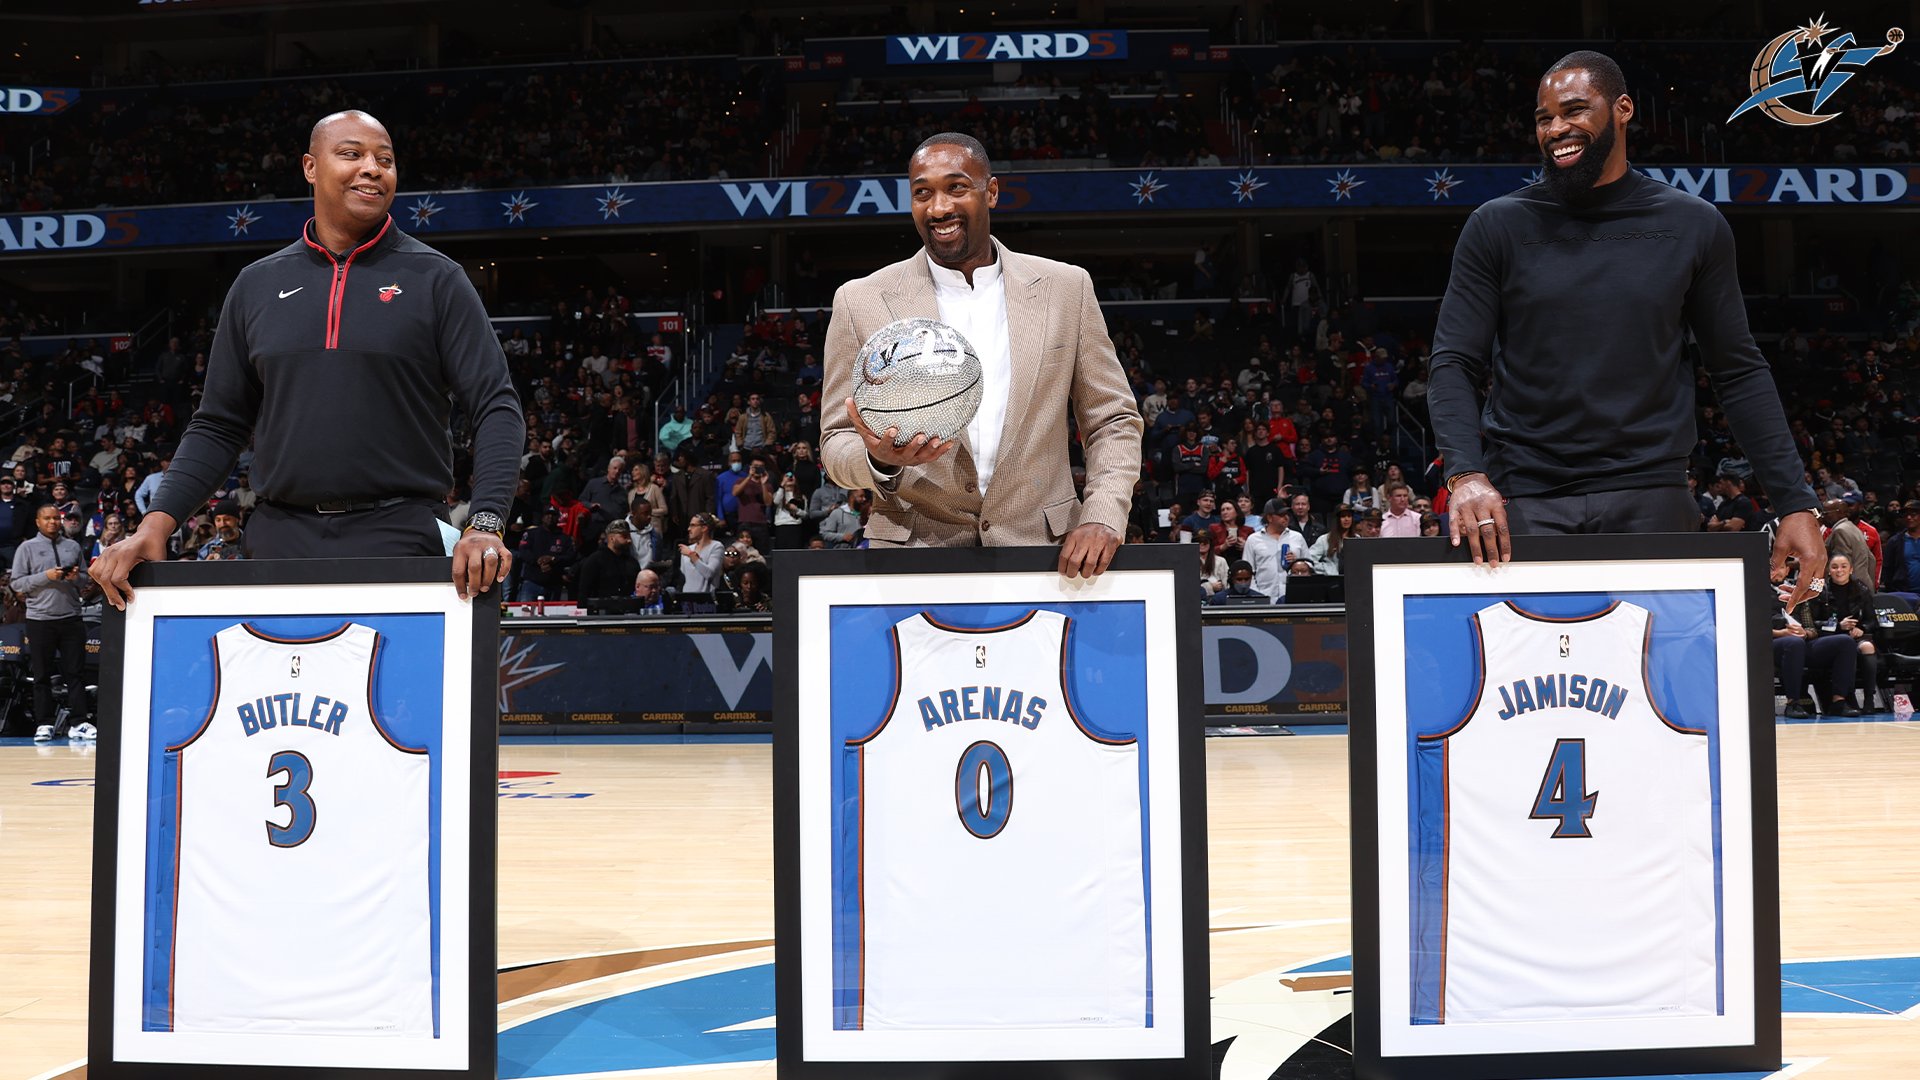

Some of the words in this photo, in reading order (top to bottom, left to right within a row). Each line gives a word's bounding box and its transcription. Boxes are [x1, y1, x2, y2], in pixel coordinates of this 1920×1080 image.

[662, 321, 679, 330] 101
[237, 692, 349, 737] BUTLER
[917, 686, 1048, 732] ARENAS
[1498, 673, 1629, 720] JAMISON
[265, 750, 317, 848] 3
[955, 740, 1014, 840] 0
[1528, 738, 1599, 838] 4
